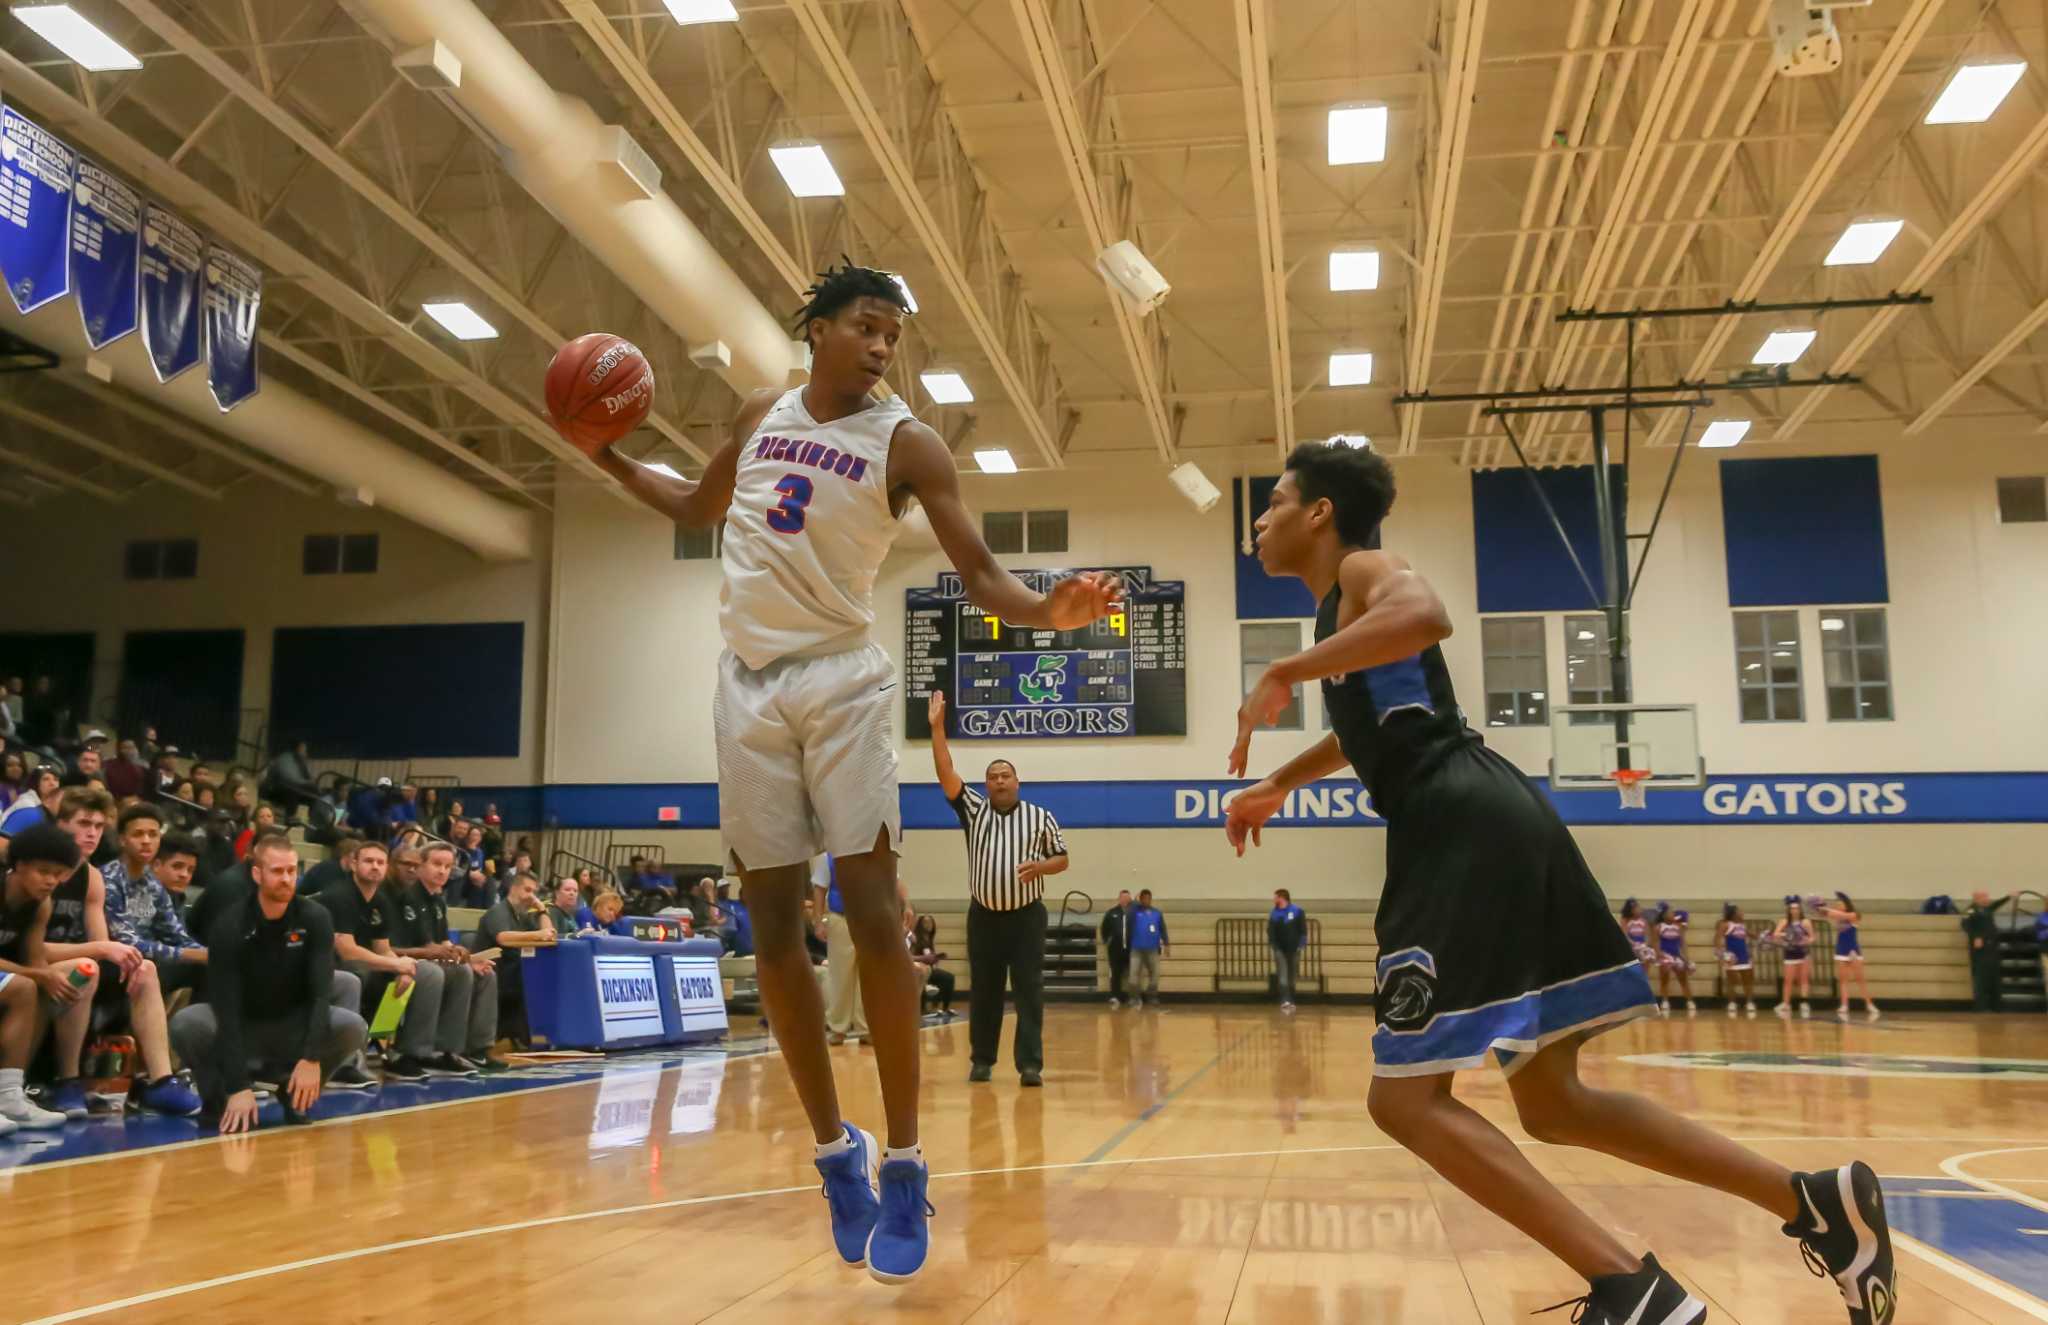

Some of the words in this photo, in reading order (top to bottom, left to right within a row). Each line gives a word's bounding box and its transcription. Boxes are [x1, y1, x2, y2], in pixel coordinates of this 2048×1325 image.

[4, 114, 73, 167] DICKINSON
[755, 435, 869, 482] DICKINSON
[766, 472, 815, 535] 3
[984, 616, 999, 640] 7
[1110, 613, 1125, 636] 9
[961, 708, 1129, 735] GATORS
[1703, 782, 1907, 815] GATORS
[601, 977, 655, 1003] DICKINSON
[679, 976, 714, 999] GATORS
